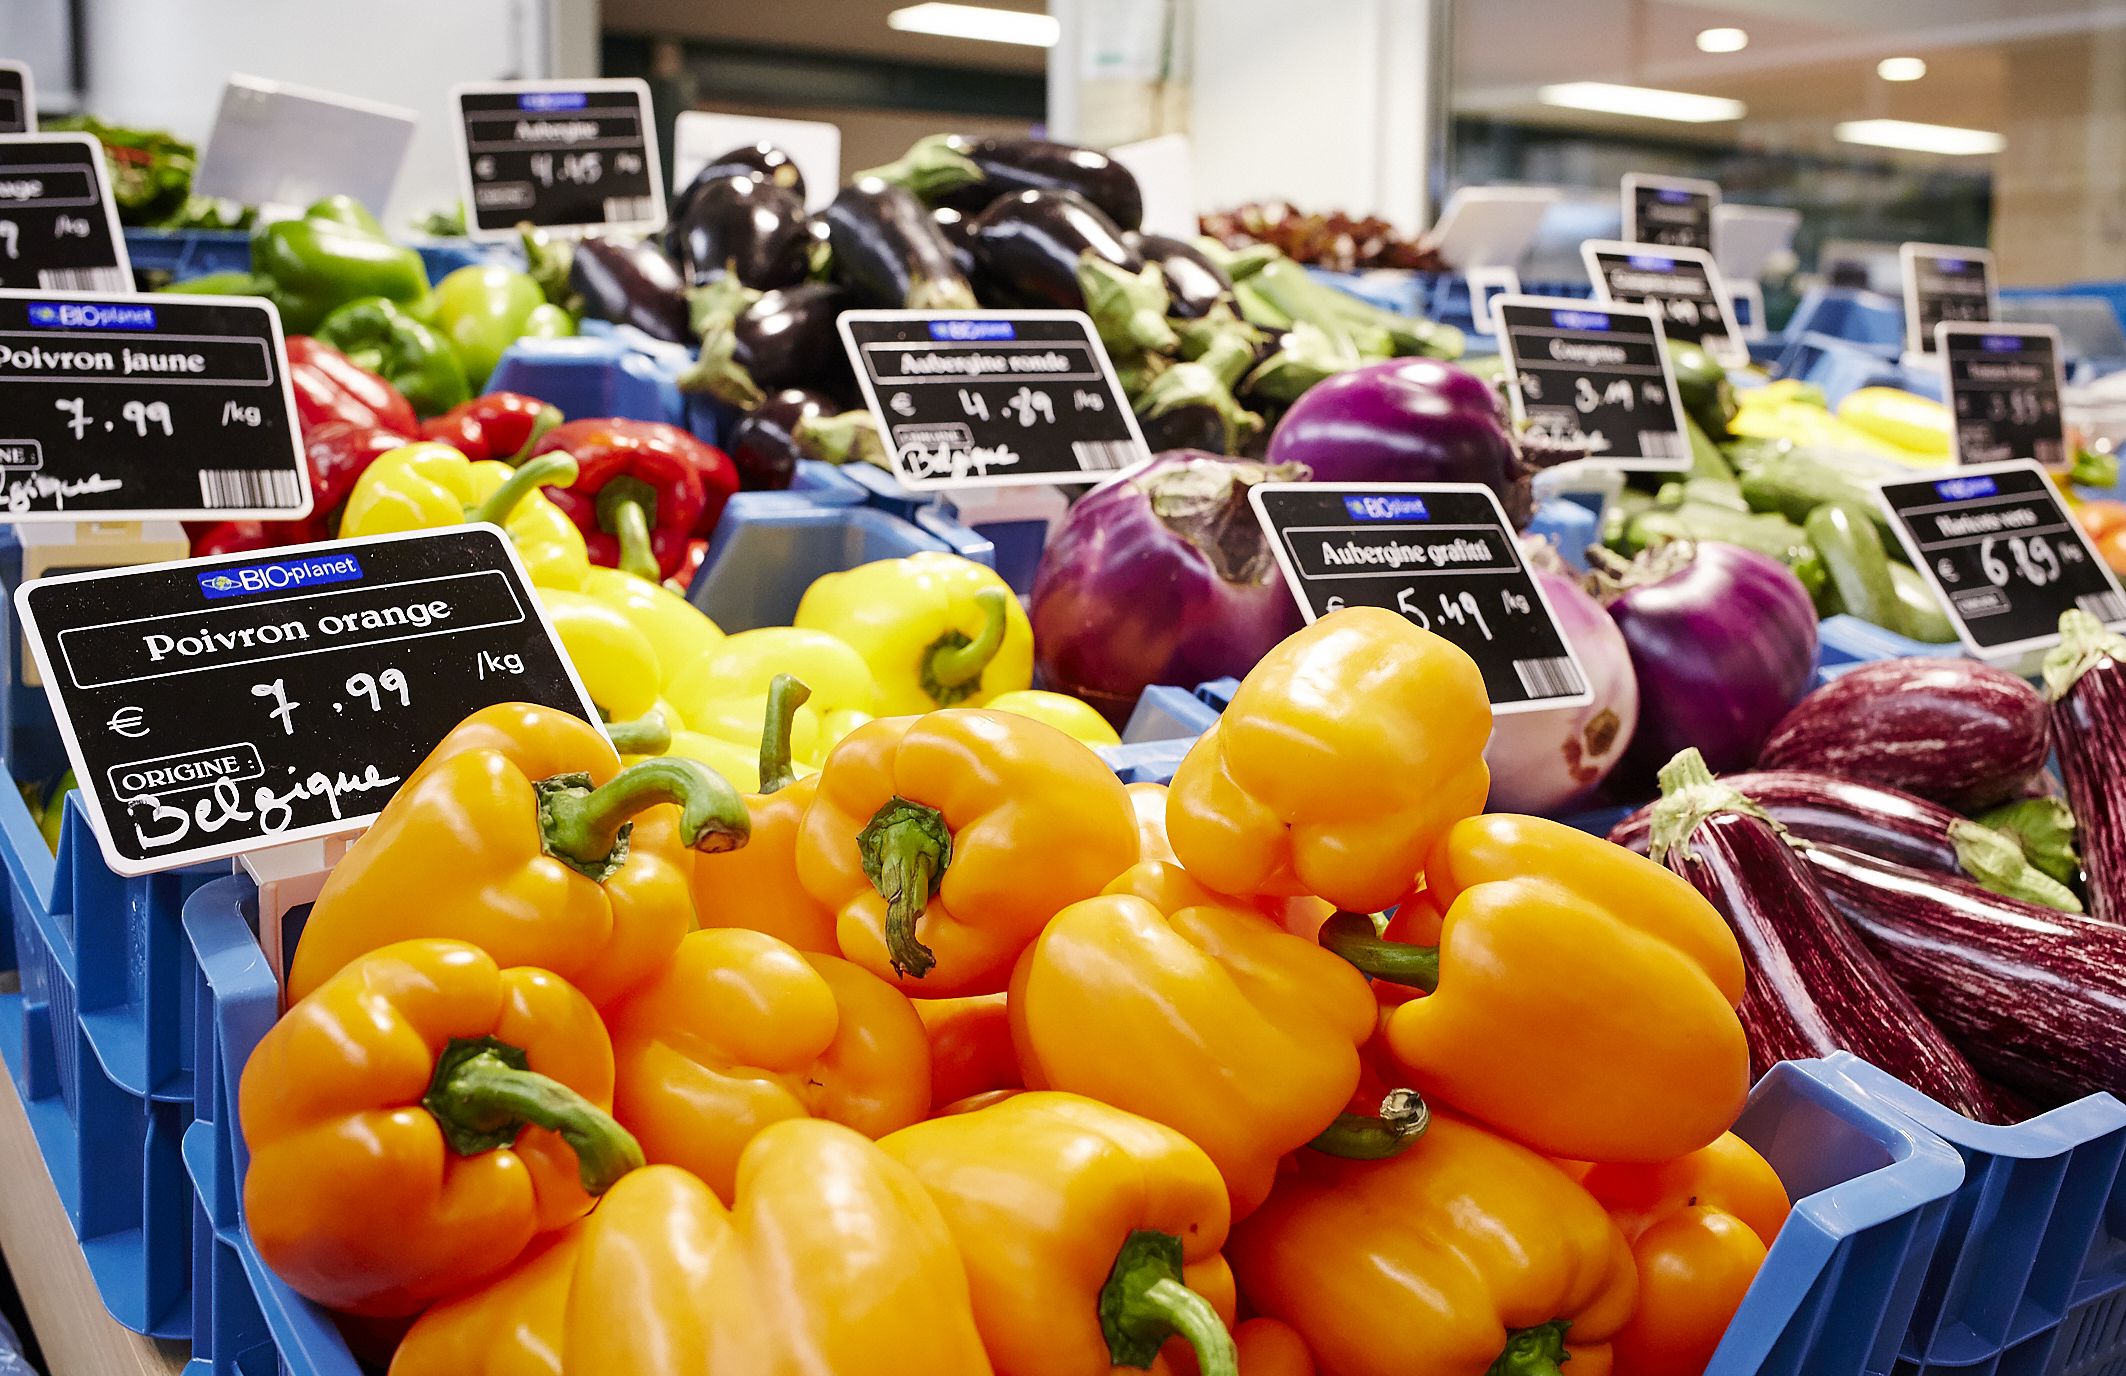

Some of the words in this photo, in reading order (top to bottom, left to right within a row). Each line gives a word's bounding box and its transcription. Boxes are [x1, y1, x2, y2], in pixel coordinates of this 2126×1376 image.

[122, 348, 206, 375] jaune
[901, 352, 1009, 378] Aubergine
[1008, 350, 1071, 374] ronde
[222, 400, 261, 427] /kg
[1322, 541, 1428, 569] Aubergine
[143, 620, 309, 662] Poivron
[318, 599, 452, 636] orange
[106, 706, 150, 738] €
[478, 650, 525, 681] /kg
[122, 756, 240, 791] ORIGINE
[127, 765, 400, 851] Belgique
